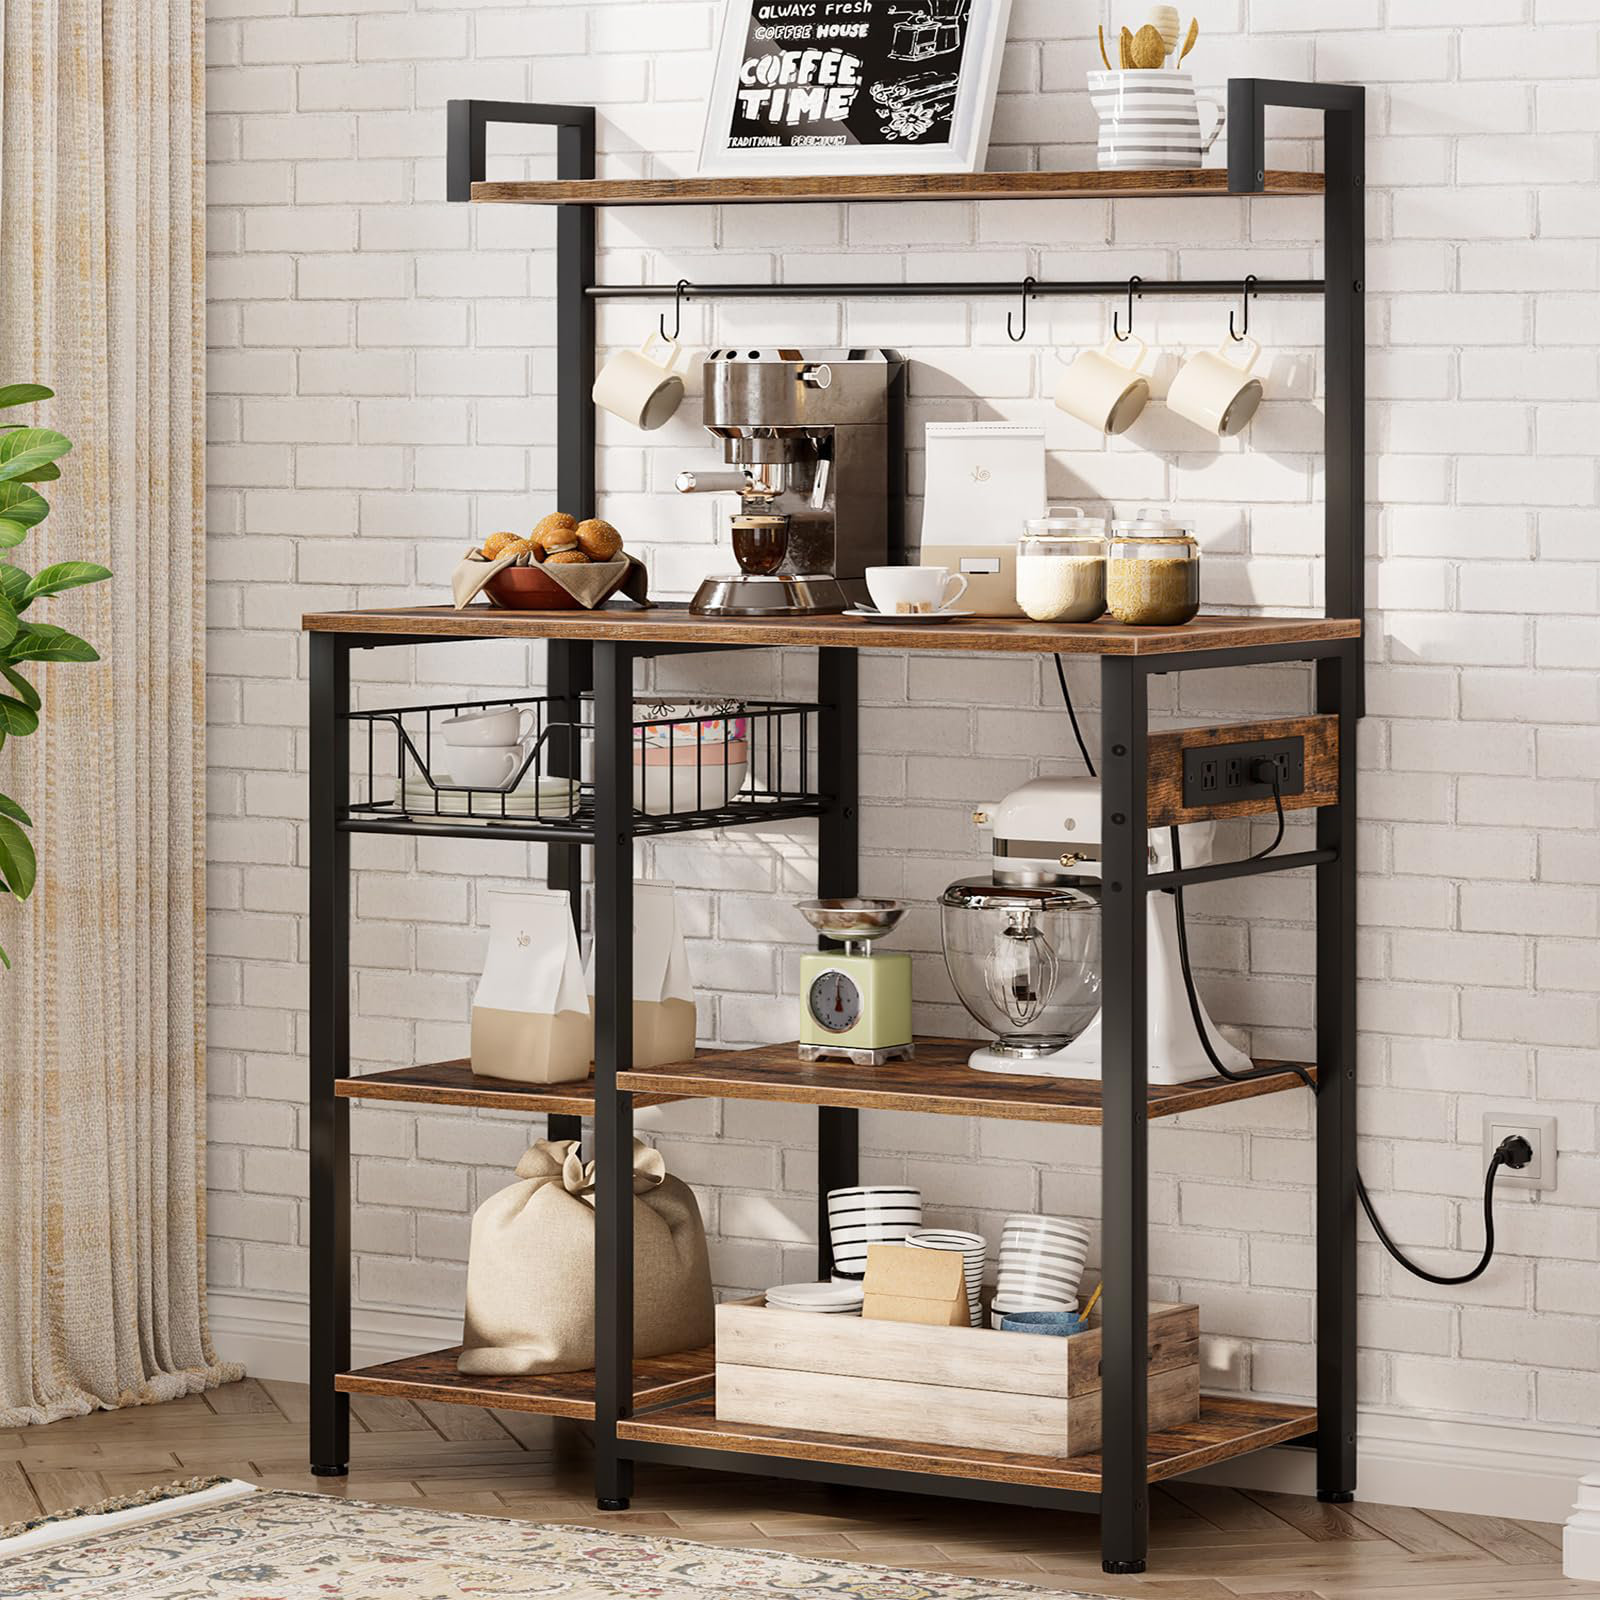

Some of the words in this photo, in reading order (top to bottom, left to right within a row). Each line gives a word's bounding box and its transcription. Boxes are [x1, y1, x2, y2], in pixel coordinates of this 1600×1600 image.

[755, 25, 813, 39] COFFEE
[816, 23, 870, 38] HOUSE
[740, 49, 863, 86] COFFEE
[739, 87, 858, 125] TIME
[728, 136, 783, 147] TRADITIONAL
[791, 135, 847, 146] PREMIUM
